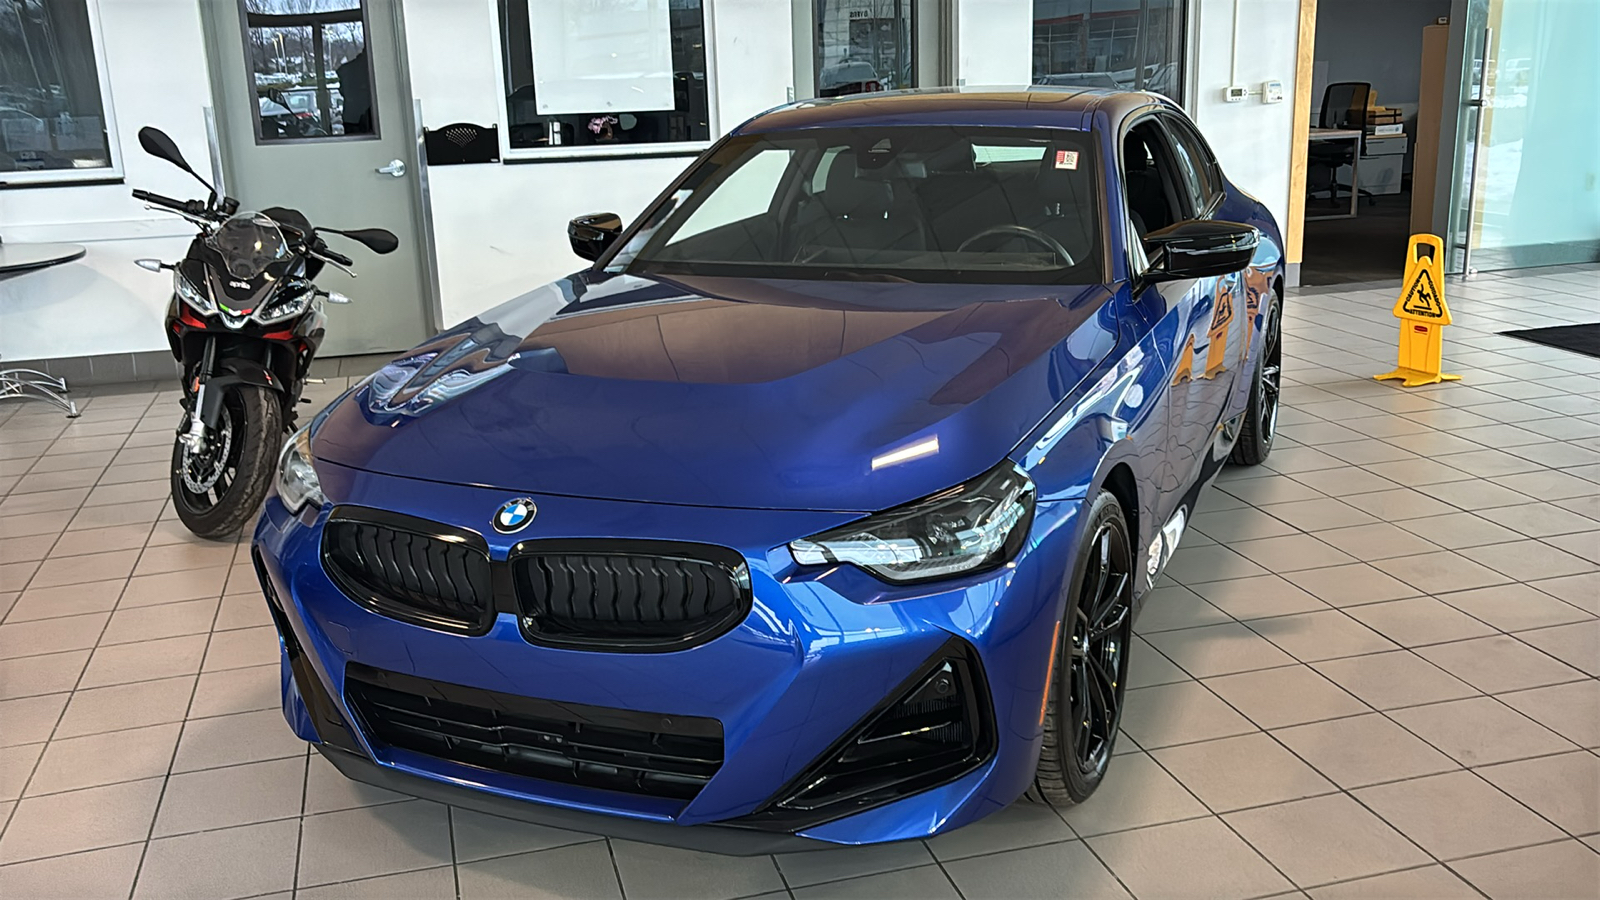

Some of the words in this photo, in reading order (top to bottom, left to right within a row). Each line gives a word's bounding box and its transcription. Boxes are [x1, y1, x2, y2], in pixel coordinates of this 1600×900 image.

[229, 281, 250, 290] aprilia
[1406, 278, 1420, 302] CAUTION
[1428, 281, 1441, 306] CUIDADO
[1409, 309, 1436, 318] ATTENTION
